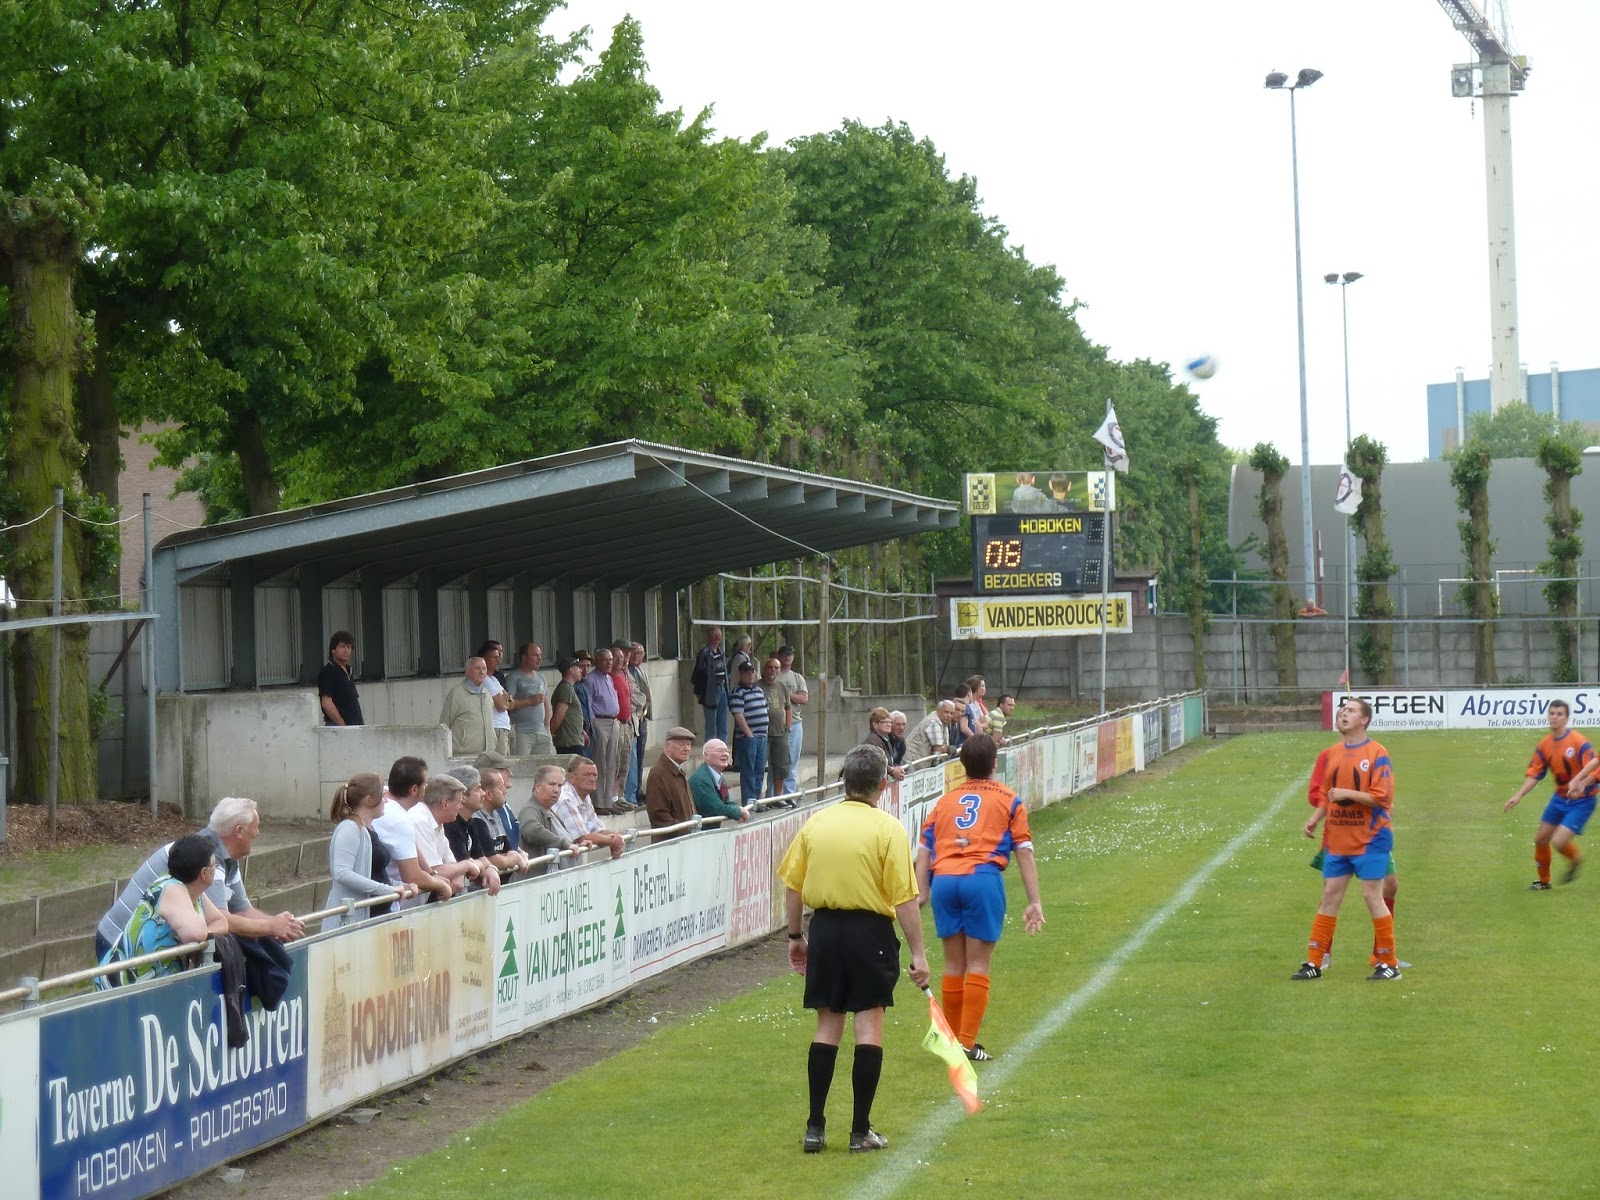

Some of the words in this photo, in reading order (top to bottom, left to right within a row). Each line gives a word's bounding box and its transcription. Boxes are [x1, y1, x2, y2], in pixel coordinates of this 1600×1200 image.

[1019, 518, 1082, 534] HOBOKEN
[984, 572, 1062, 589] BEZOEKERS
[986, 603, 1113, 628] VANDENBROUCKE
[1487, 719, 1500, 727] Tel.
[980, 786, 1014, 799] TRAITEUR
[955, 793, 982, 830] 3
[1330, 809, 1365, 819] ADAMS
[540, 880, 593, 925] HOUTHANDEL
[391, 927, 415, 977] DEN
[526, 937, 550, 986] VAN
[551, 929, 575, 978] DEN
[577, 918, 606, 969] EEDE
[613, 936, 626, 962] HOUT
[497, 976, 519, 1005] HOUT
[351, 969, 451, 1070] HOBOKENAAR
[49, 1074, 137, 1146] Taverne
[141, 1013, 181, 1115] De
[187, 994, 304, 1099] Schorren
[77, 1128, 168, 1198] HOBOKEN
[190, 1081, 288, 1153] POLDERSTAD
